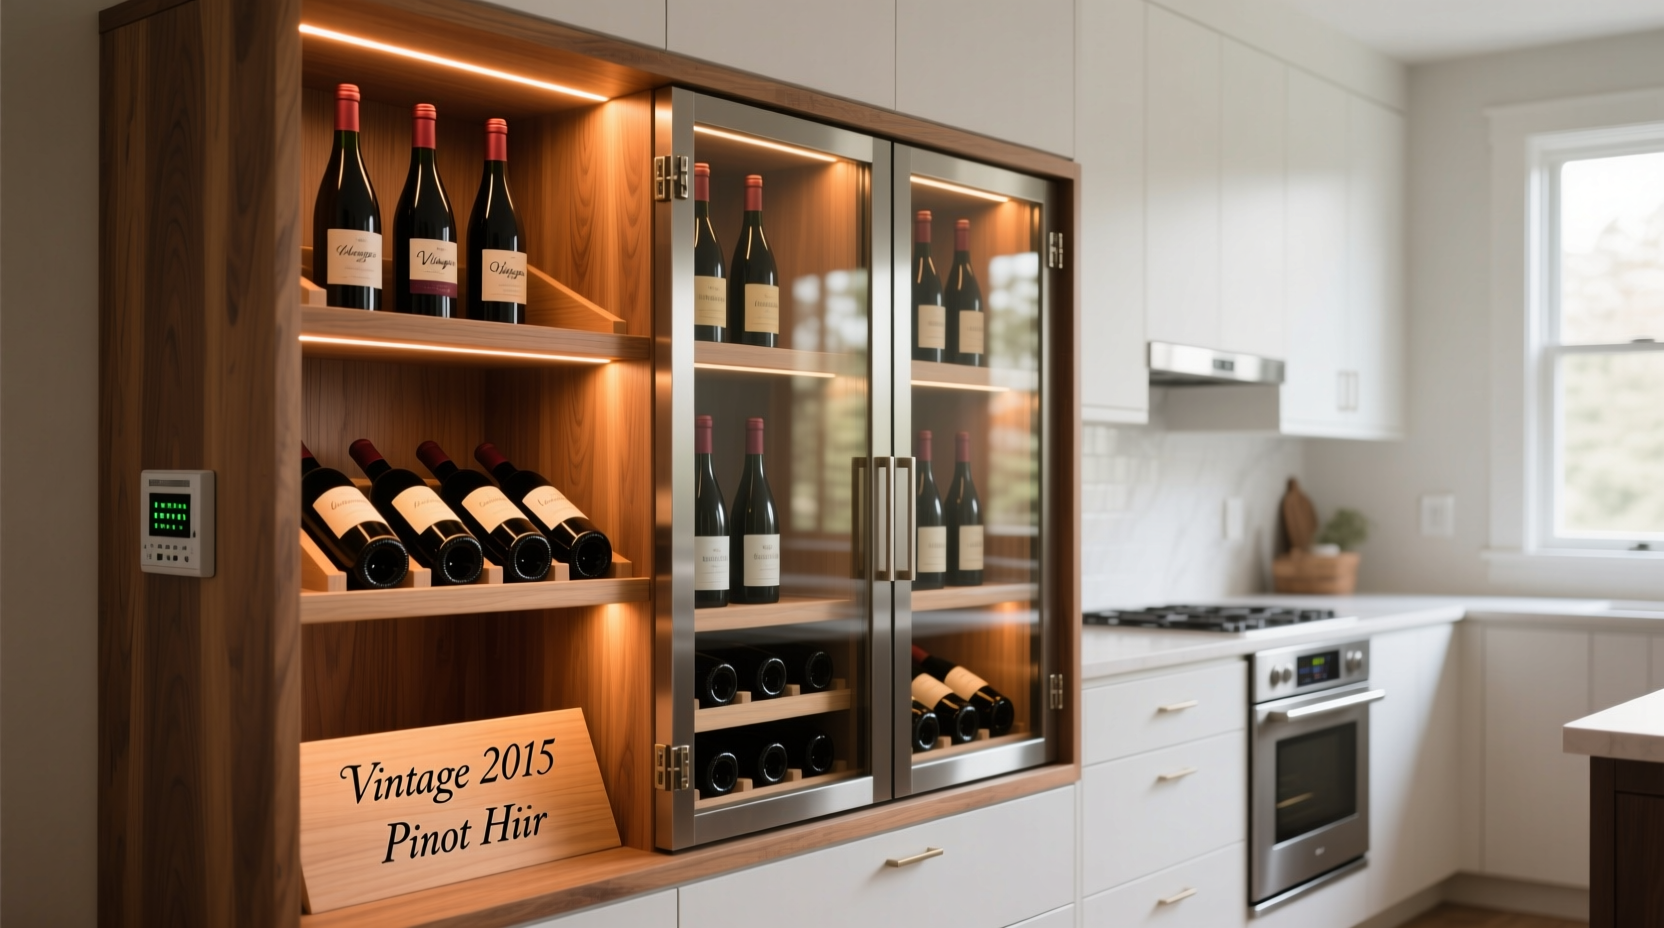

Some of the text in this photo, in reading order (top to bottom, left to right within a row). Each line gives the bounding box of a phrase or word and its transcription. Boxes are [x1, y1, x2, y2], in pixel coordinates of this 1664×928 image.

[340, 738, 556, 804] Vintage 2015
[382, 804, 548, 864] Pinot Hiir
